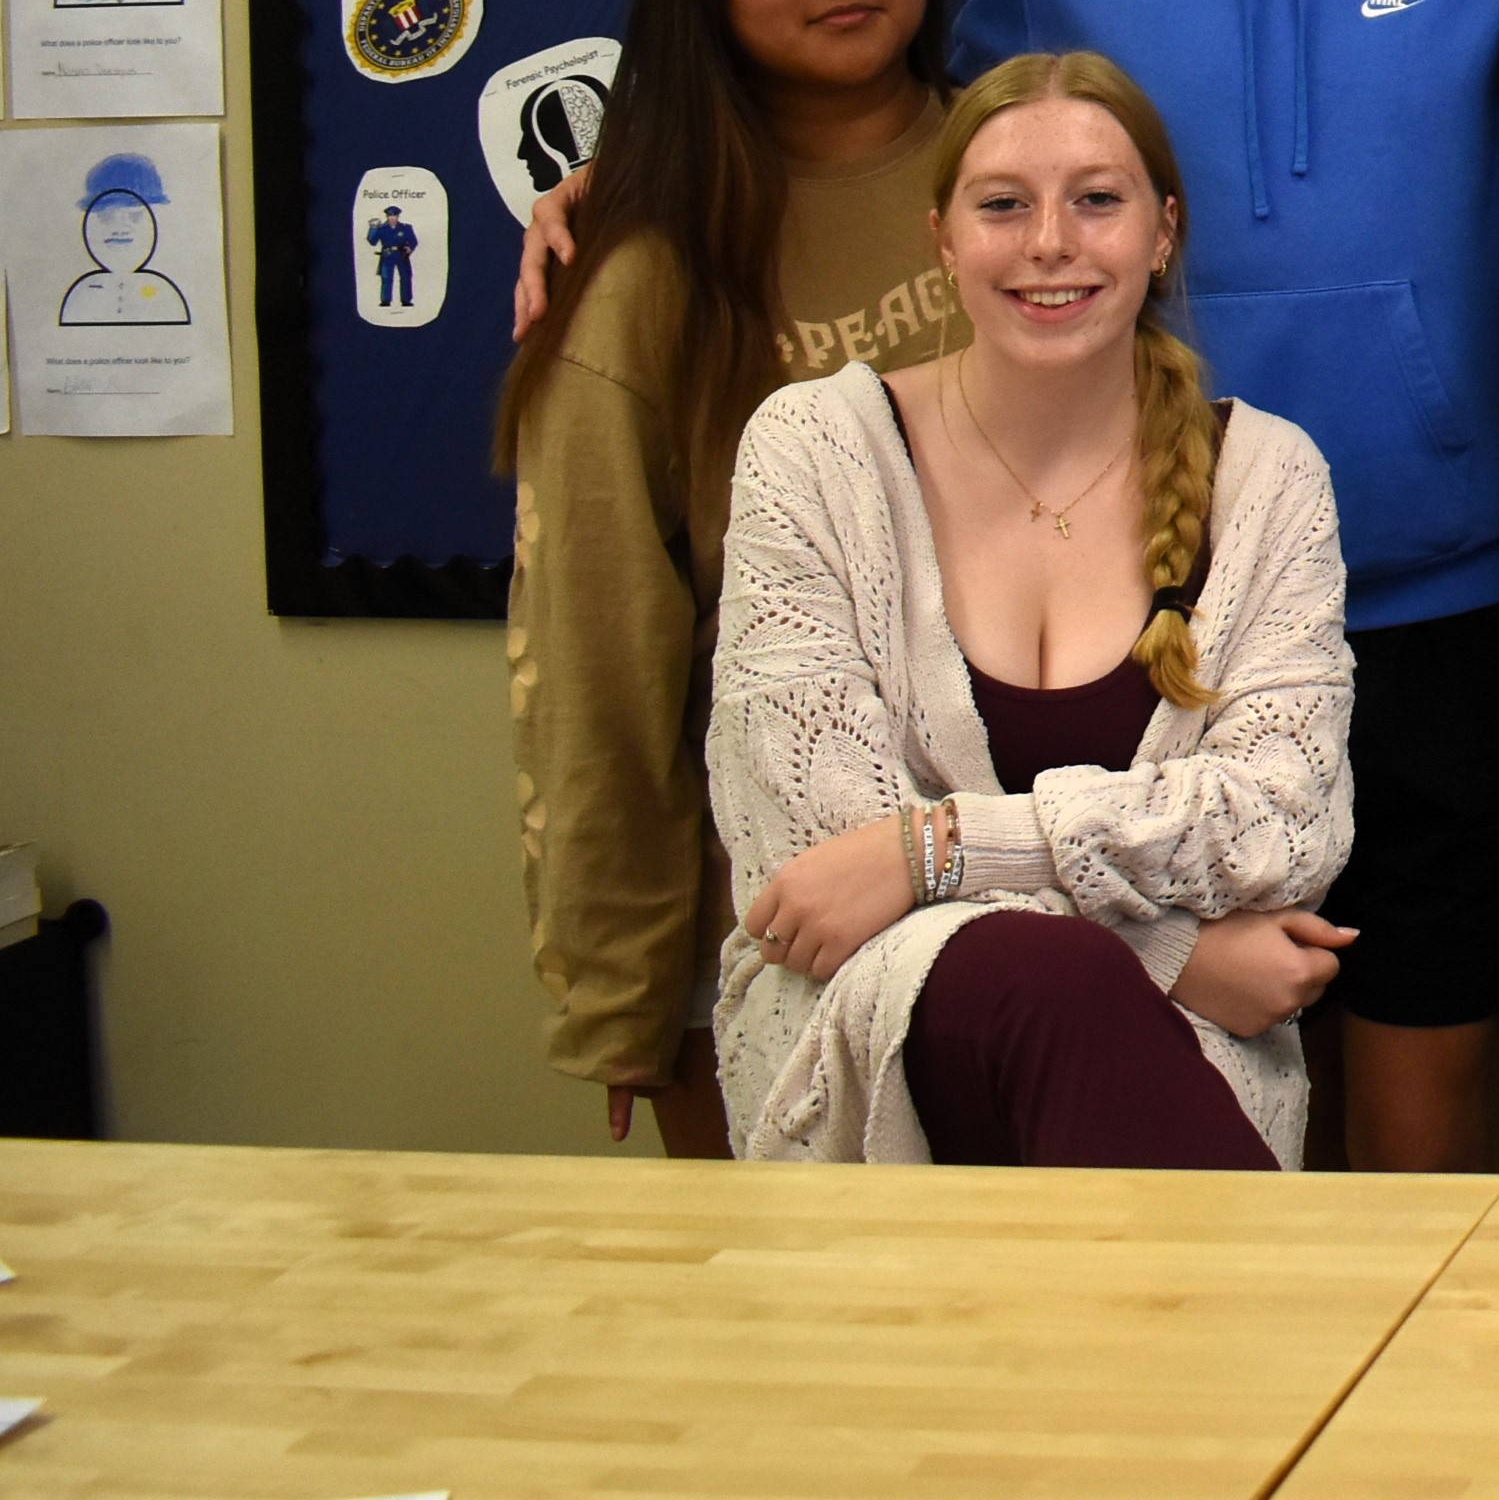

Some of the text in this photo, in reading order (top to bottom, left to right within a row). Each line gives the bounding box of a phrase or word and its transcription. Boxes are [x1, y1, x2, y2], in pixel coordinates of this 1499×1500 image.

[506, 50, 599, 89] Forensic Psychologist
[363, 189, 426, 199] Police Officer
[795, 267, 956, 369] PEAC
